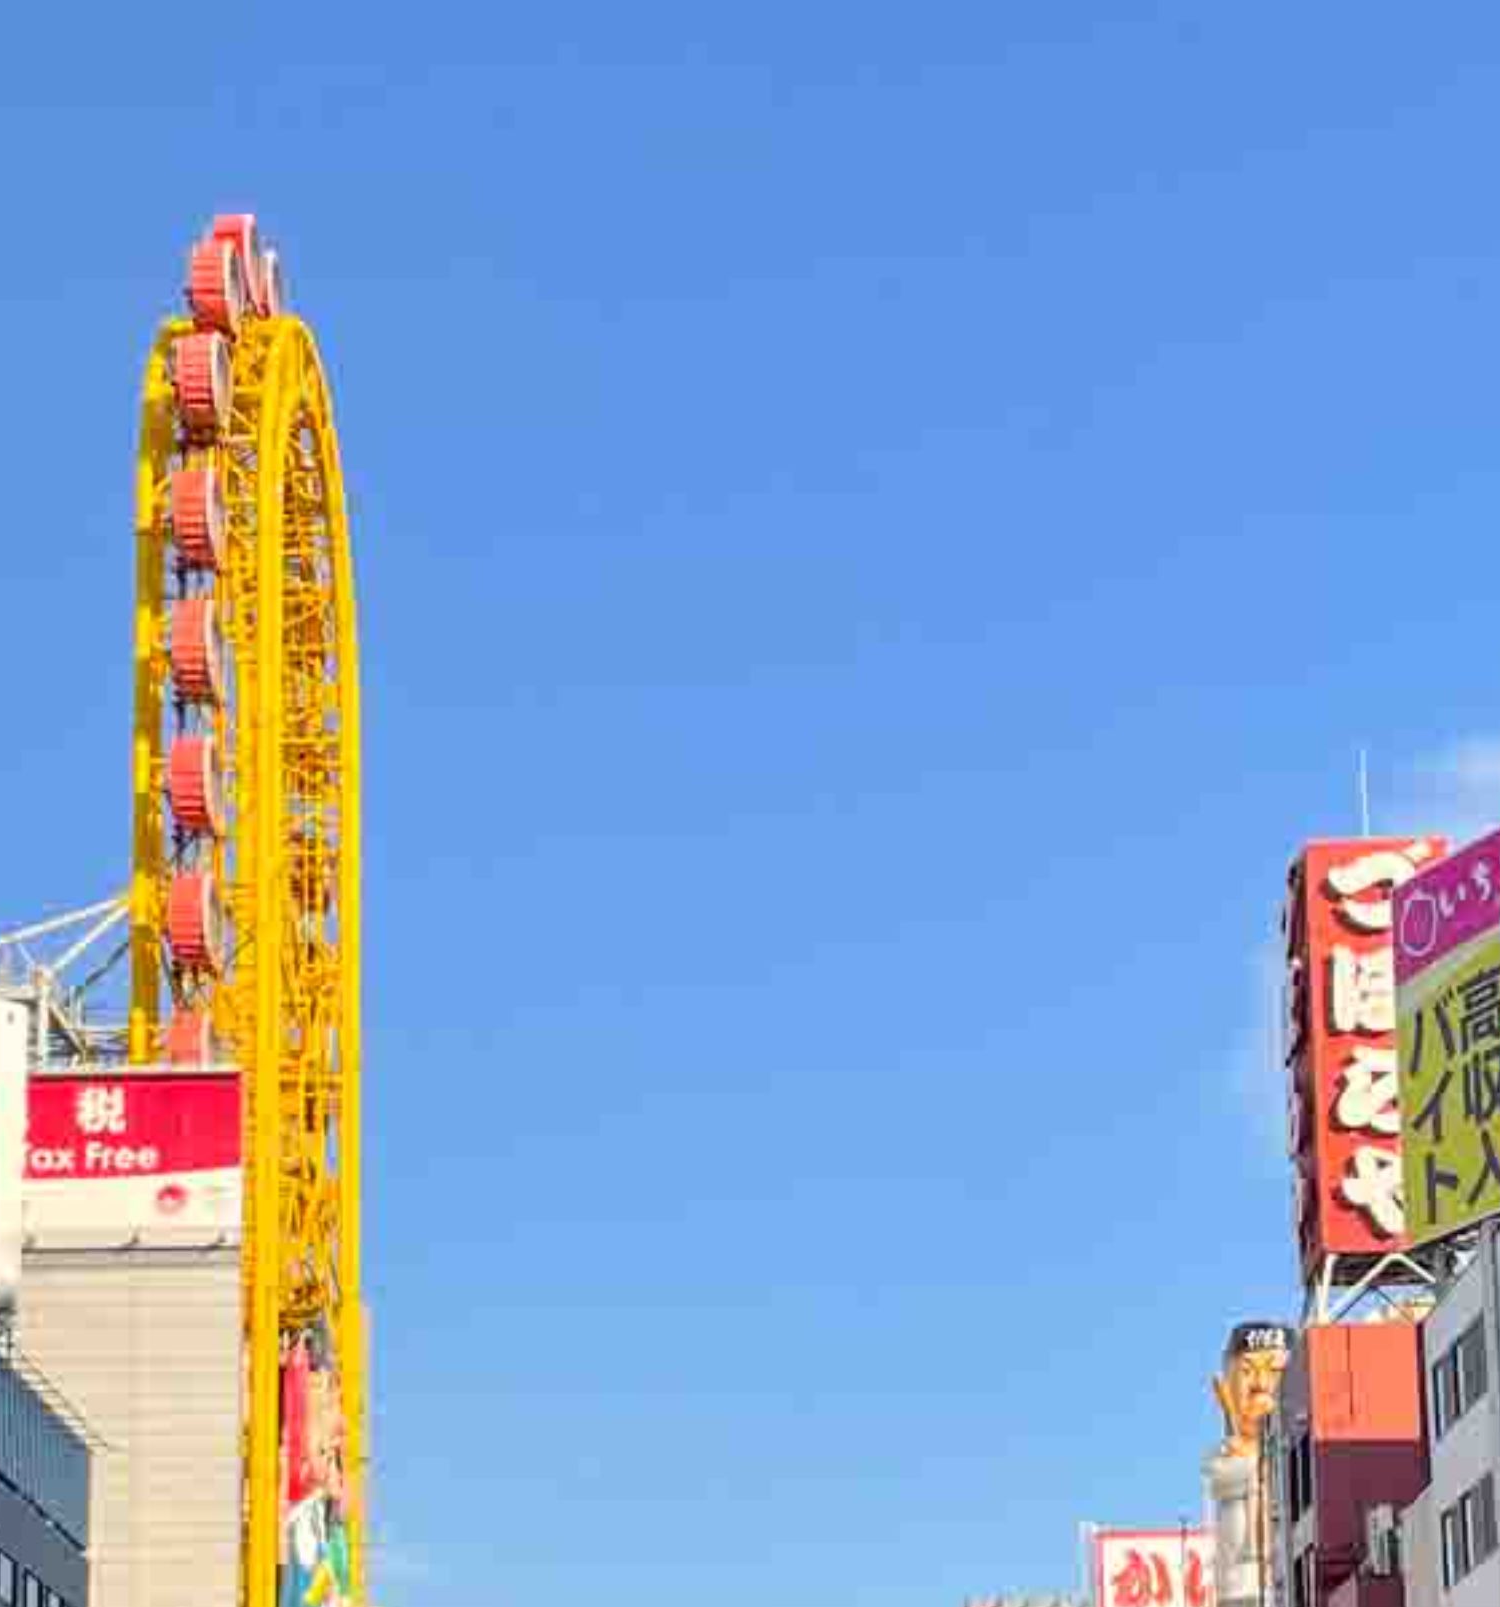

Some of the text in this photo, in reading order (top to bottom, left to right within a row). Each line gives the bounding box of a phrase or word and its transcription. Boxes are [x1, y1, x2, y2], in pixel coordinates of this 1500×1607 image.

[28, 1142, 159, 1170] ax Free
[1408, 985, 1460, 1225] バイト
